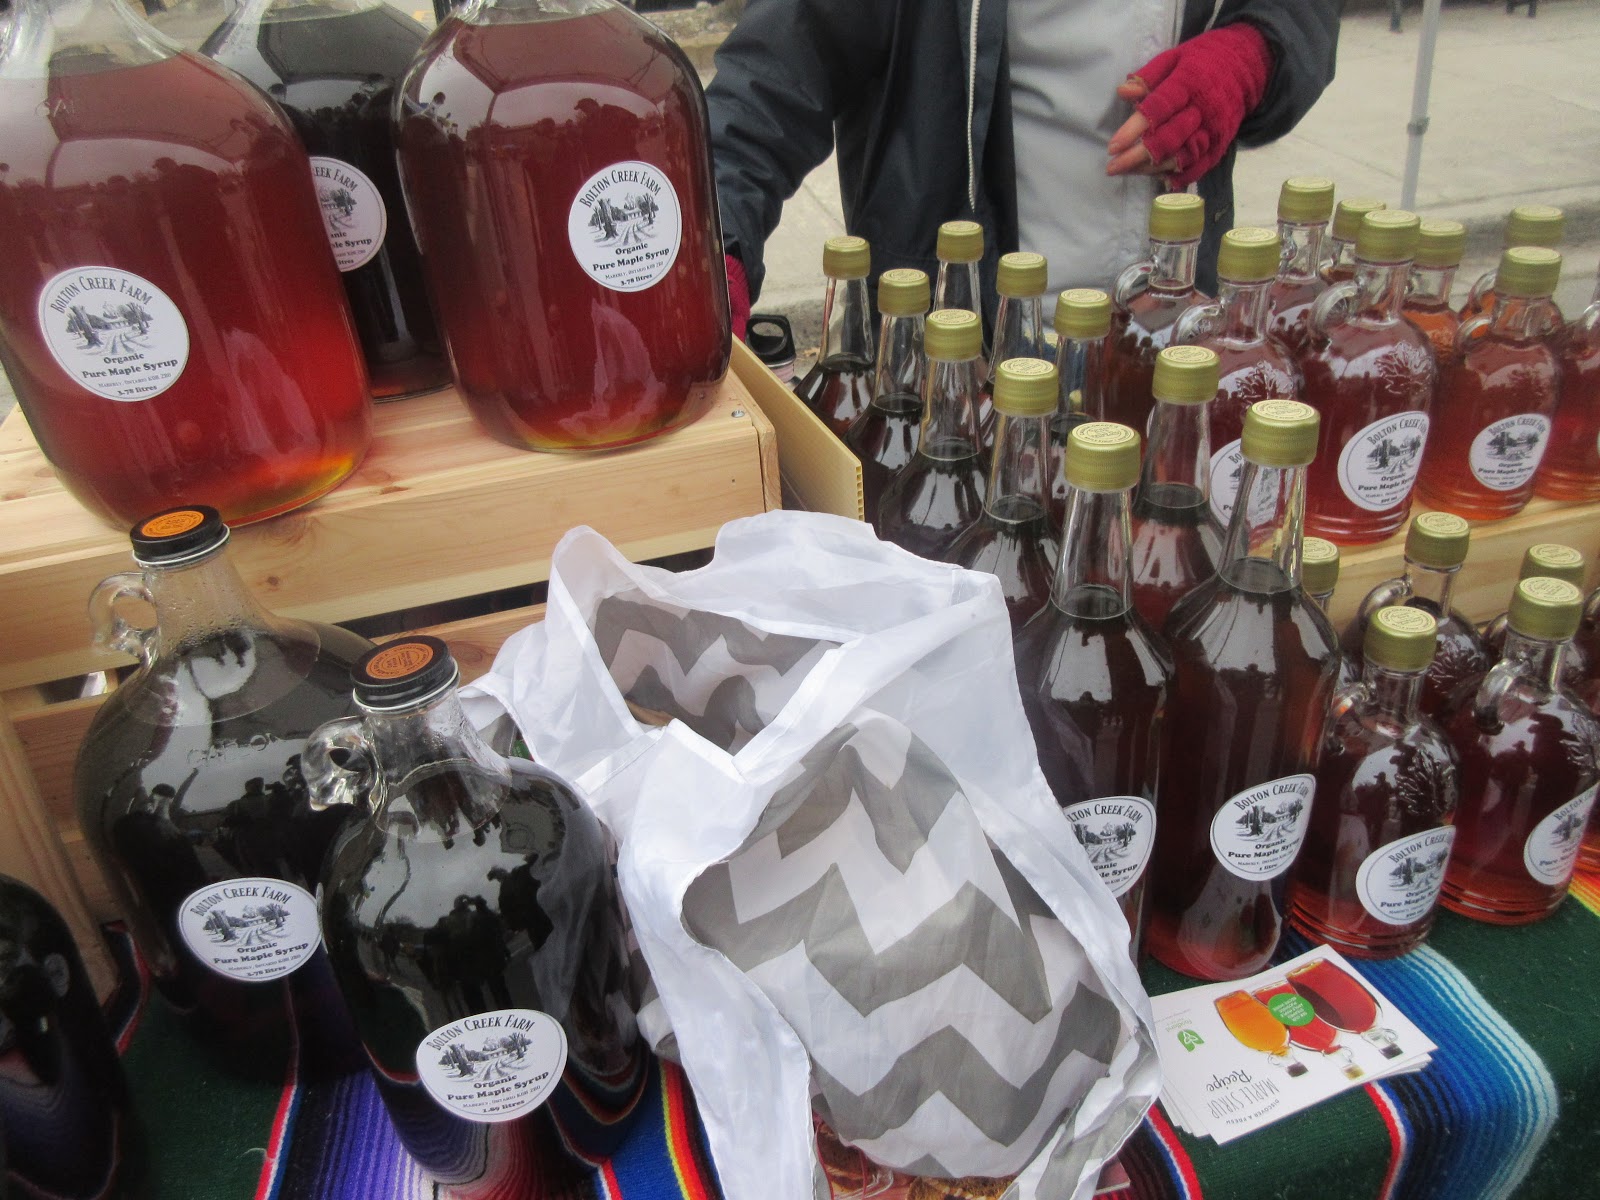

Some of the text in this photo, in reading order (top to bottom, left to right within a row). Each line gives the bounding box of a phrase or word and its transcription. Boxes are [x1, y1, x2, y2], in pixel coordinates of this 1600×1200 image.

[314, 166, 358, 191] EEK FARM
[579, 170, 661, 208] BOLTON CREEK FARM
[345, 238, 372, 248] Syrup
[615, 243, 648, 255] Organic
[593, 248, 670, 272] Pure Maple Syrup
[636, 273, 653, 282] litres
[51, 276, 153, 314] BOLTON CREEK FARM
[103, 353, 145, 365] Organic
[82, 359, 178, 379] Pure Maple Syrup
[136, 384, 158, 393] litres
[1367, 423, 1397, 445] BOLTON
[1400, 418, 1420, 429] CREEK
[1379, 482, 1400, 490] Maple
[1381, 473, 1406, 482] Organic
[1234, 789, 1270, 810] BOLTON
[1273, 783, 1299, 796] CREEK
[1067, 804, 1143, 823] LTON CREEK FARM
[1255, 838, 1287, 850] Organic
[1388, 841, 1422, 863] BOLTON
[1228, 851, 1251, 859] Pure
[1253, 848, 1280, 858] Maple
[1093, 862, 1117, 871] ganic
[1111, 864, 1138, 876] Syrup
[190, 886, 293, 917] BOLTON CREEK FARM
[237, 942, 278, 954] Organic
[241, 952, 273, 963] Maple
[275, 942, 309, 956] Syrup
[265, 965, 287, 974] litres
[426, 1014, 535, 1051] BOLTON CREEK FARM
[447, 1071, 550, 1101] Pure Maple Syrup
[473, 1074, 518, 1089] Organic
[1206, 1069, 1252, 1092] Recipe
[502, 1100, 525, 1110] litres
[1207, 1077, 1280, 1119] MAPLE SYRUP
[1254, 1099, 1280, 1118] DISCOVER
[1226, 1117, 1247, 1125] FRESH
